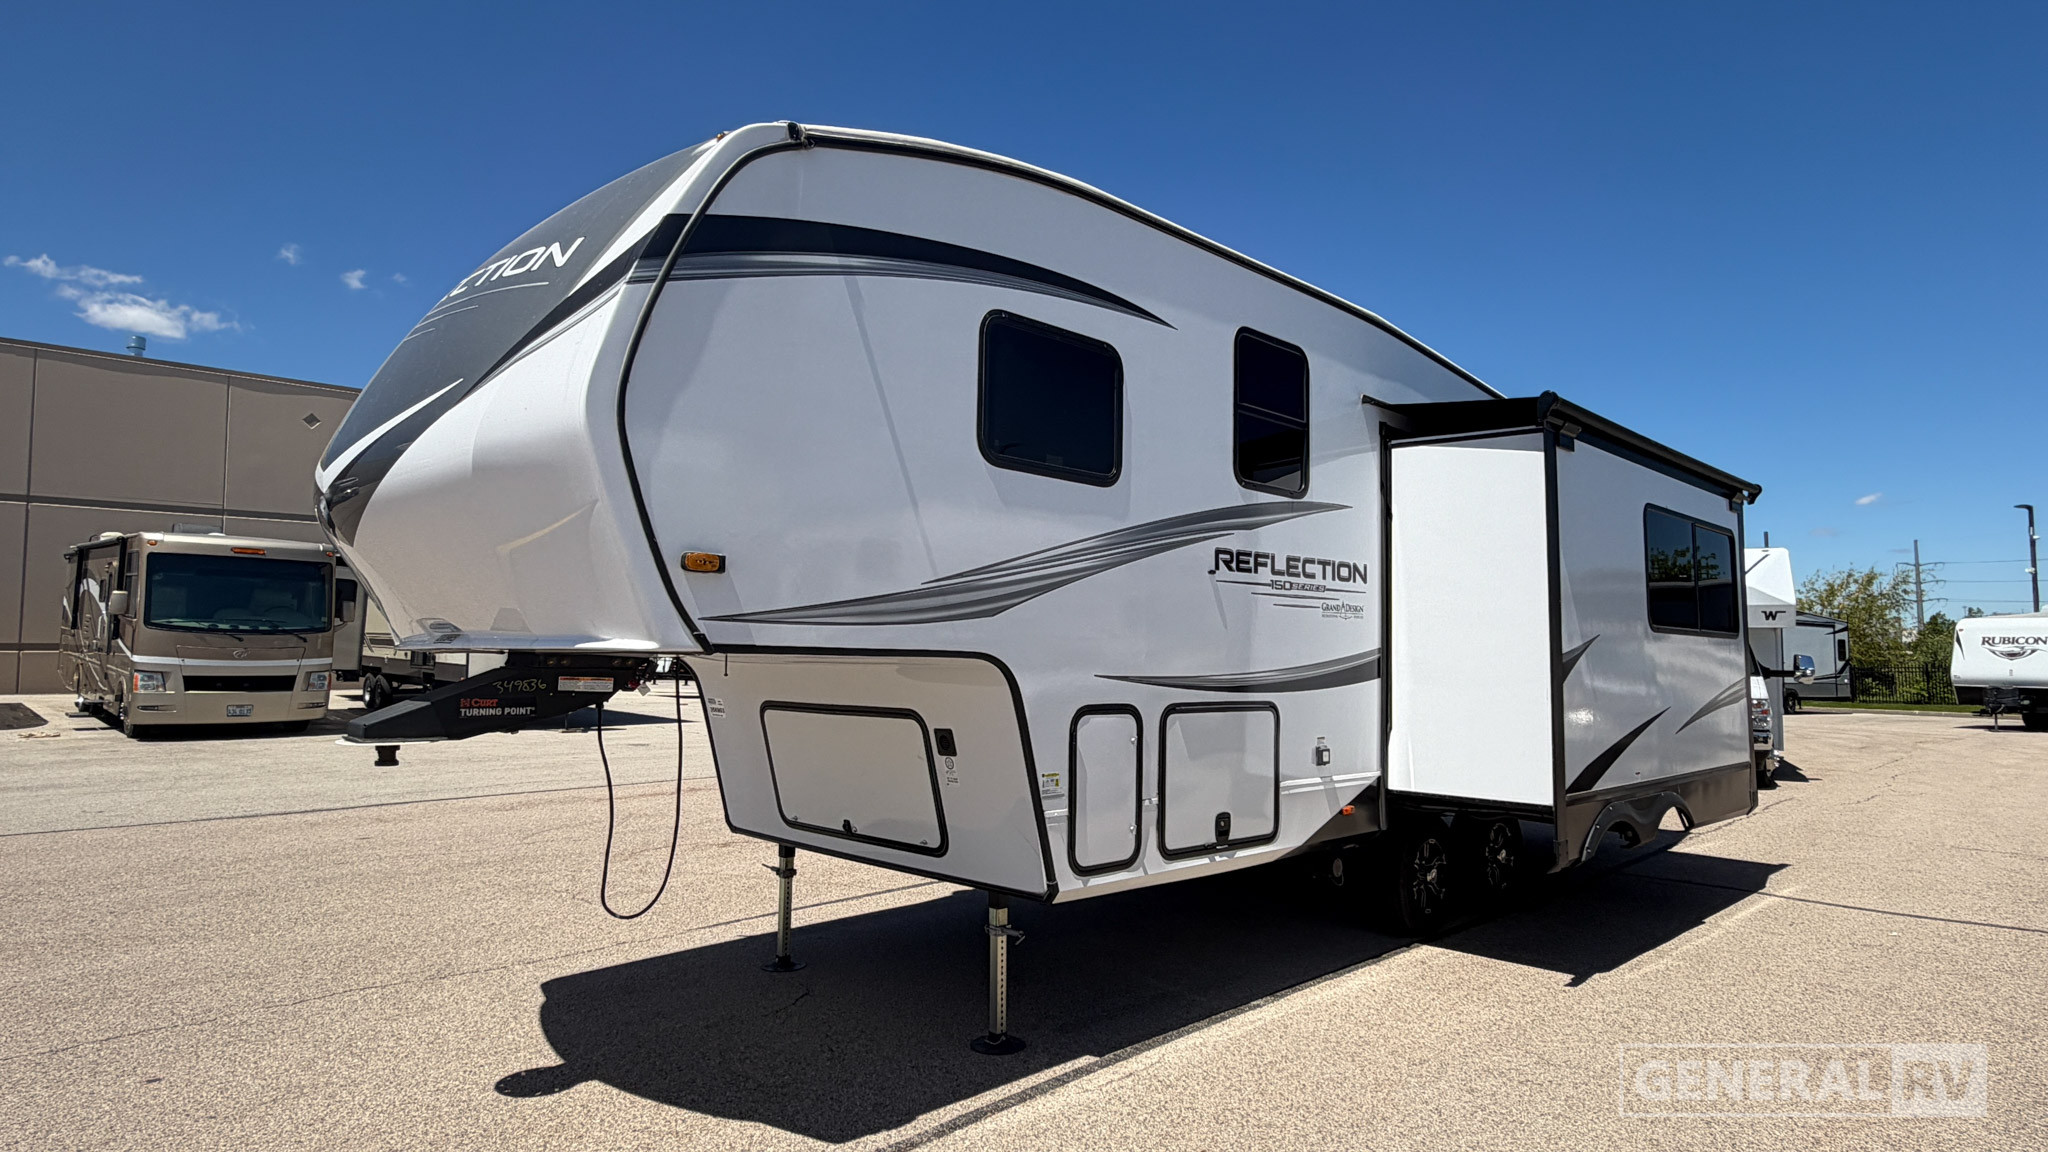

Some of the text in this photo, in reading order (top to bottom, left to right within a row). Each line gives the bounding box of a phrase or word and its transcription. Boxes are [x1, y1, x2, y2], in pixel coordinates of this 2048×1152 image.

[1212, 547, 1368, 585] REFLECTION
[1291, 582, 1326, 593] SERIES
[1321, 602, 1364, 613] GRAND DESIGN
[1981, 636, 2048, 647] RUBICON
[492, 678, 547, 694] 349836
[471, 698, 499, 708] CURT
[460, 707, 502, 717] TURNING
